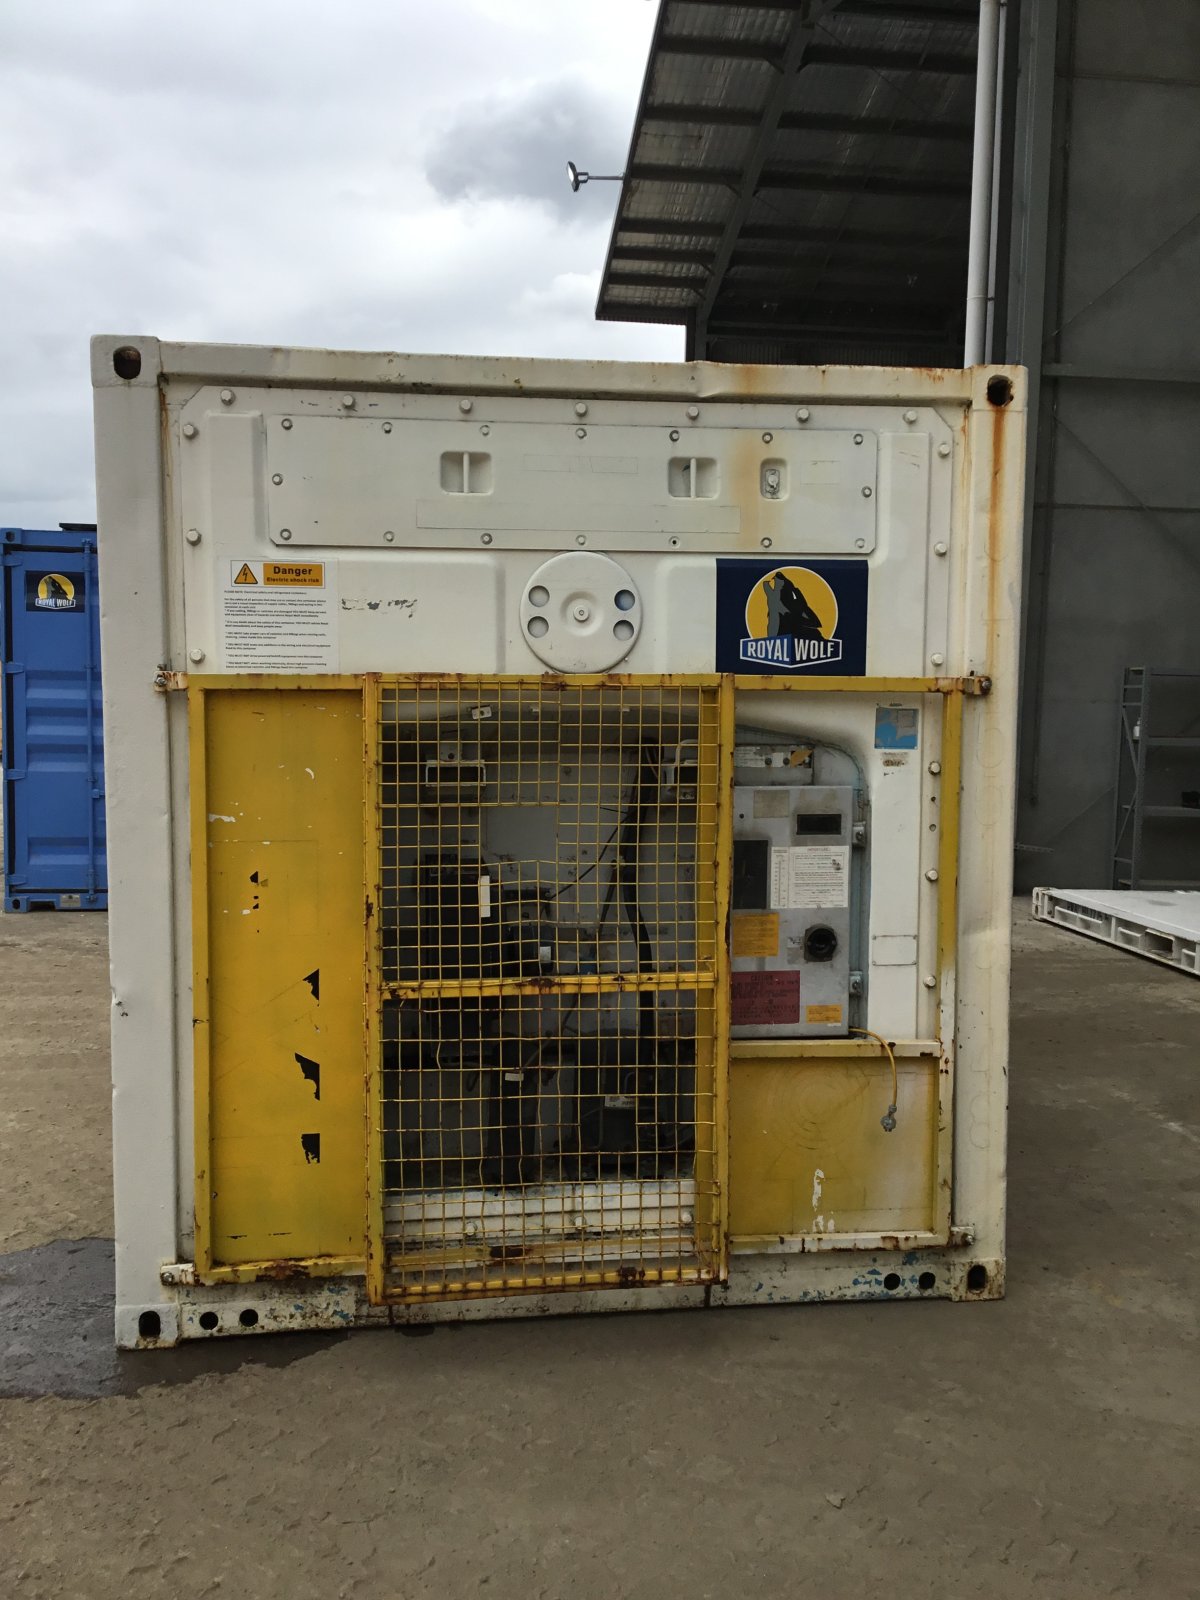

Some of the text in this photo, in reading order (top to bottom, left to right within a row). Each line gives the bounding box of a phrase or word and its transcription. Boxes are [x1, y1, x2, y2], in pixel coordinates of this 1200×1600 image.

[273, 566, 312, 576] Danger
[38, 598, 73, 607] ROYAL WOLF
[747, 638, 835, 662] ROYAL WOLF
